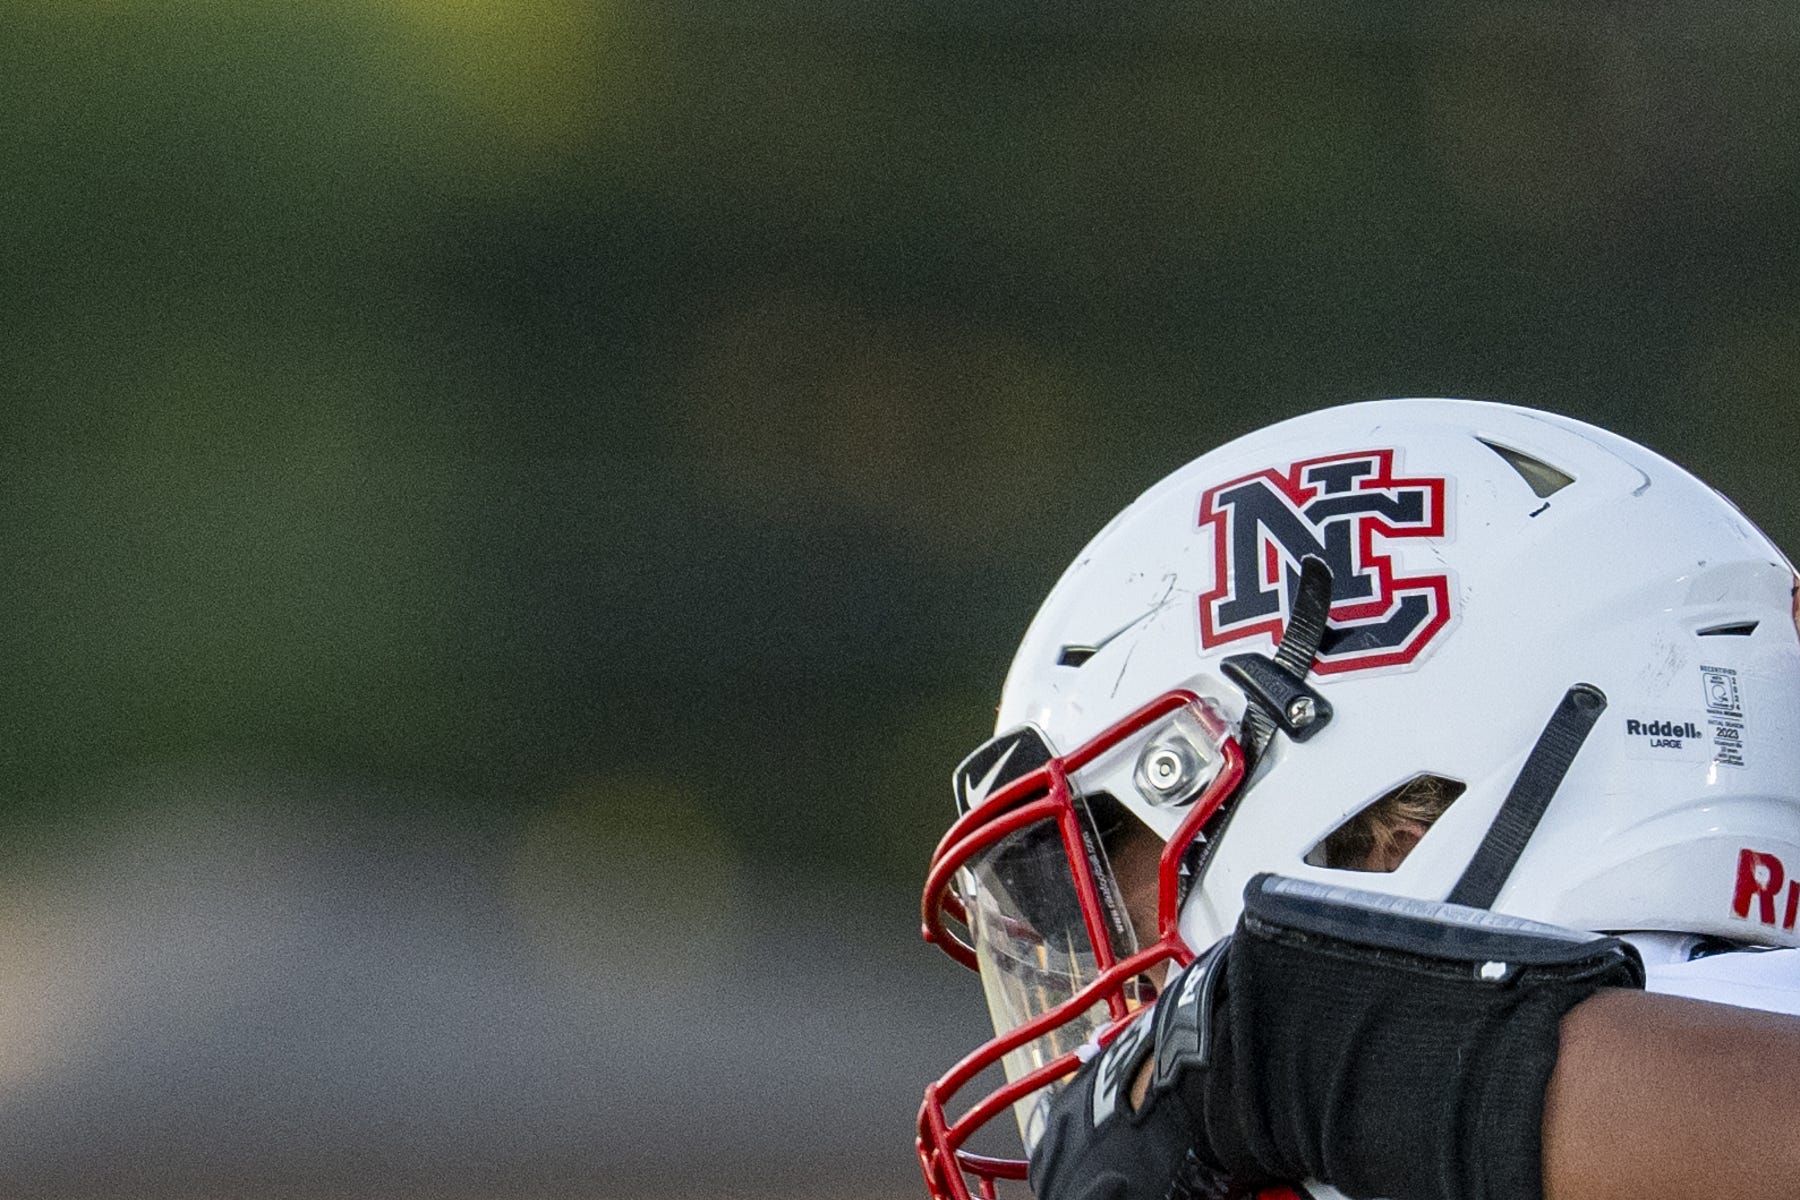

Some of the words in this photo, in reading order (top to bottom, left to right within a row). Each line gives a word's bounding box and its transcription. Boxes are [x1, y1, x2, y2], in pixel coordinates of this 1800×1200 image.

[1199, 449, 1451, 676] NC
[1627, 719, 1697, 739] Riddell
[1650, 739, 1683, 749] LARGE
